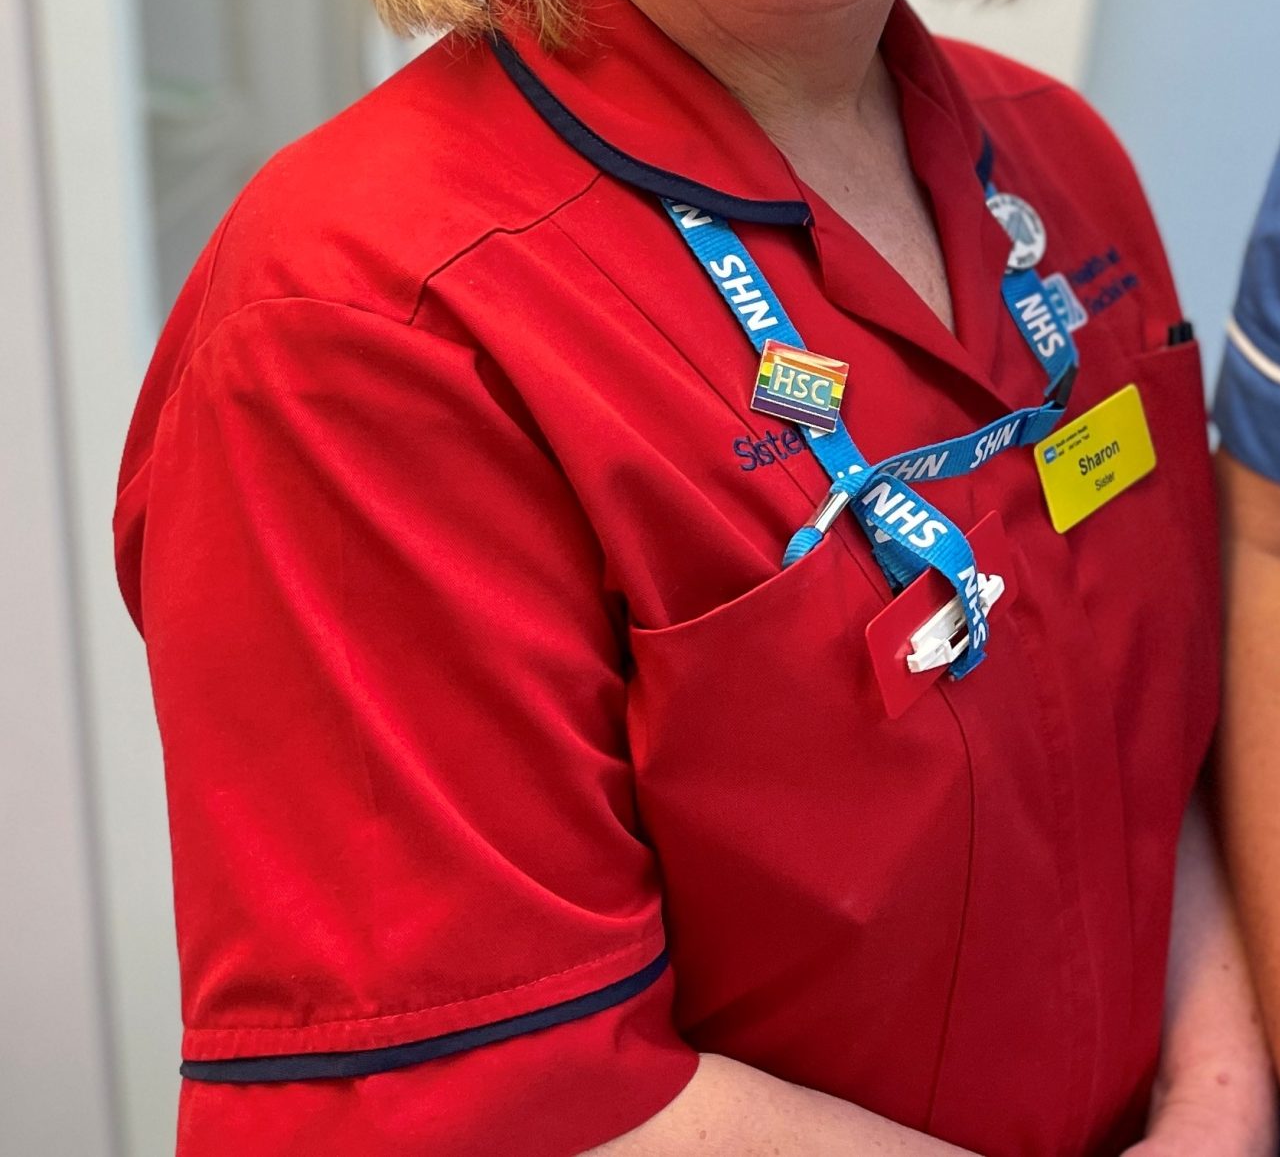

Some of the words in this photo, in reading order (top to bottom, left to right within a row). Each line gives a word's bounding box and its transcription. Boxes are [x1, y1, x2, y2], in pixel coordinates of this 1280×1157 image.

[710, 254, 779, 331] NHS
[1015, 293, 1065, 357] NHS
[773, 365, 830, 405] HSC
[733, 427, 808, 471] Siste
[970, 419, 1021, 469] NHS
[1078, 440, 1120, 476] Sharon
[1094, 471, 1115, 491] Sister
[861, 481, 949, 548] NHS
[957, 565, 986, 650] NHS
